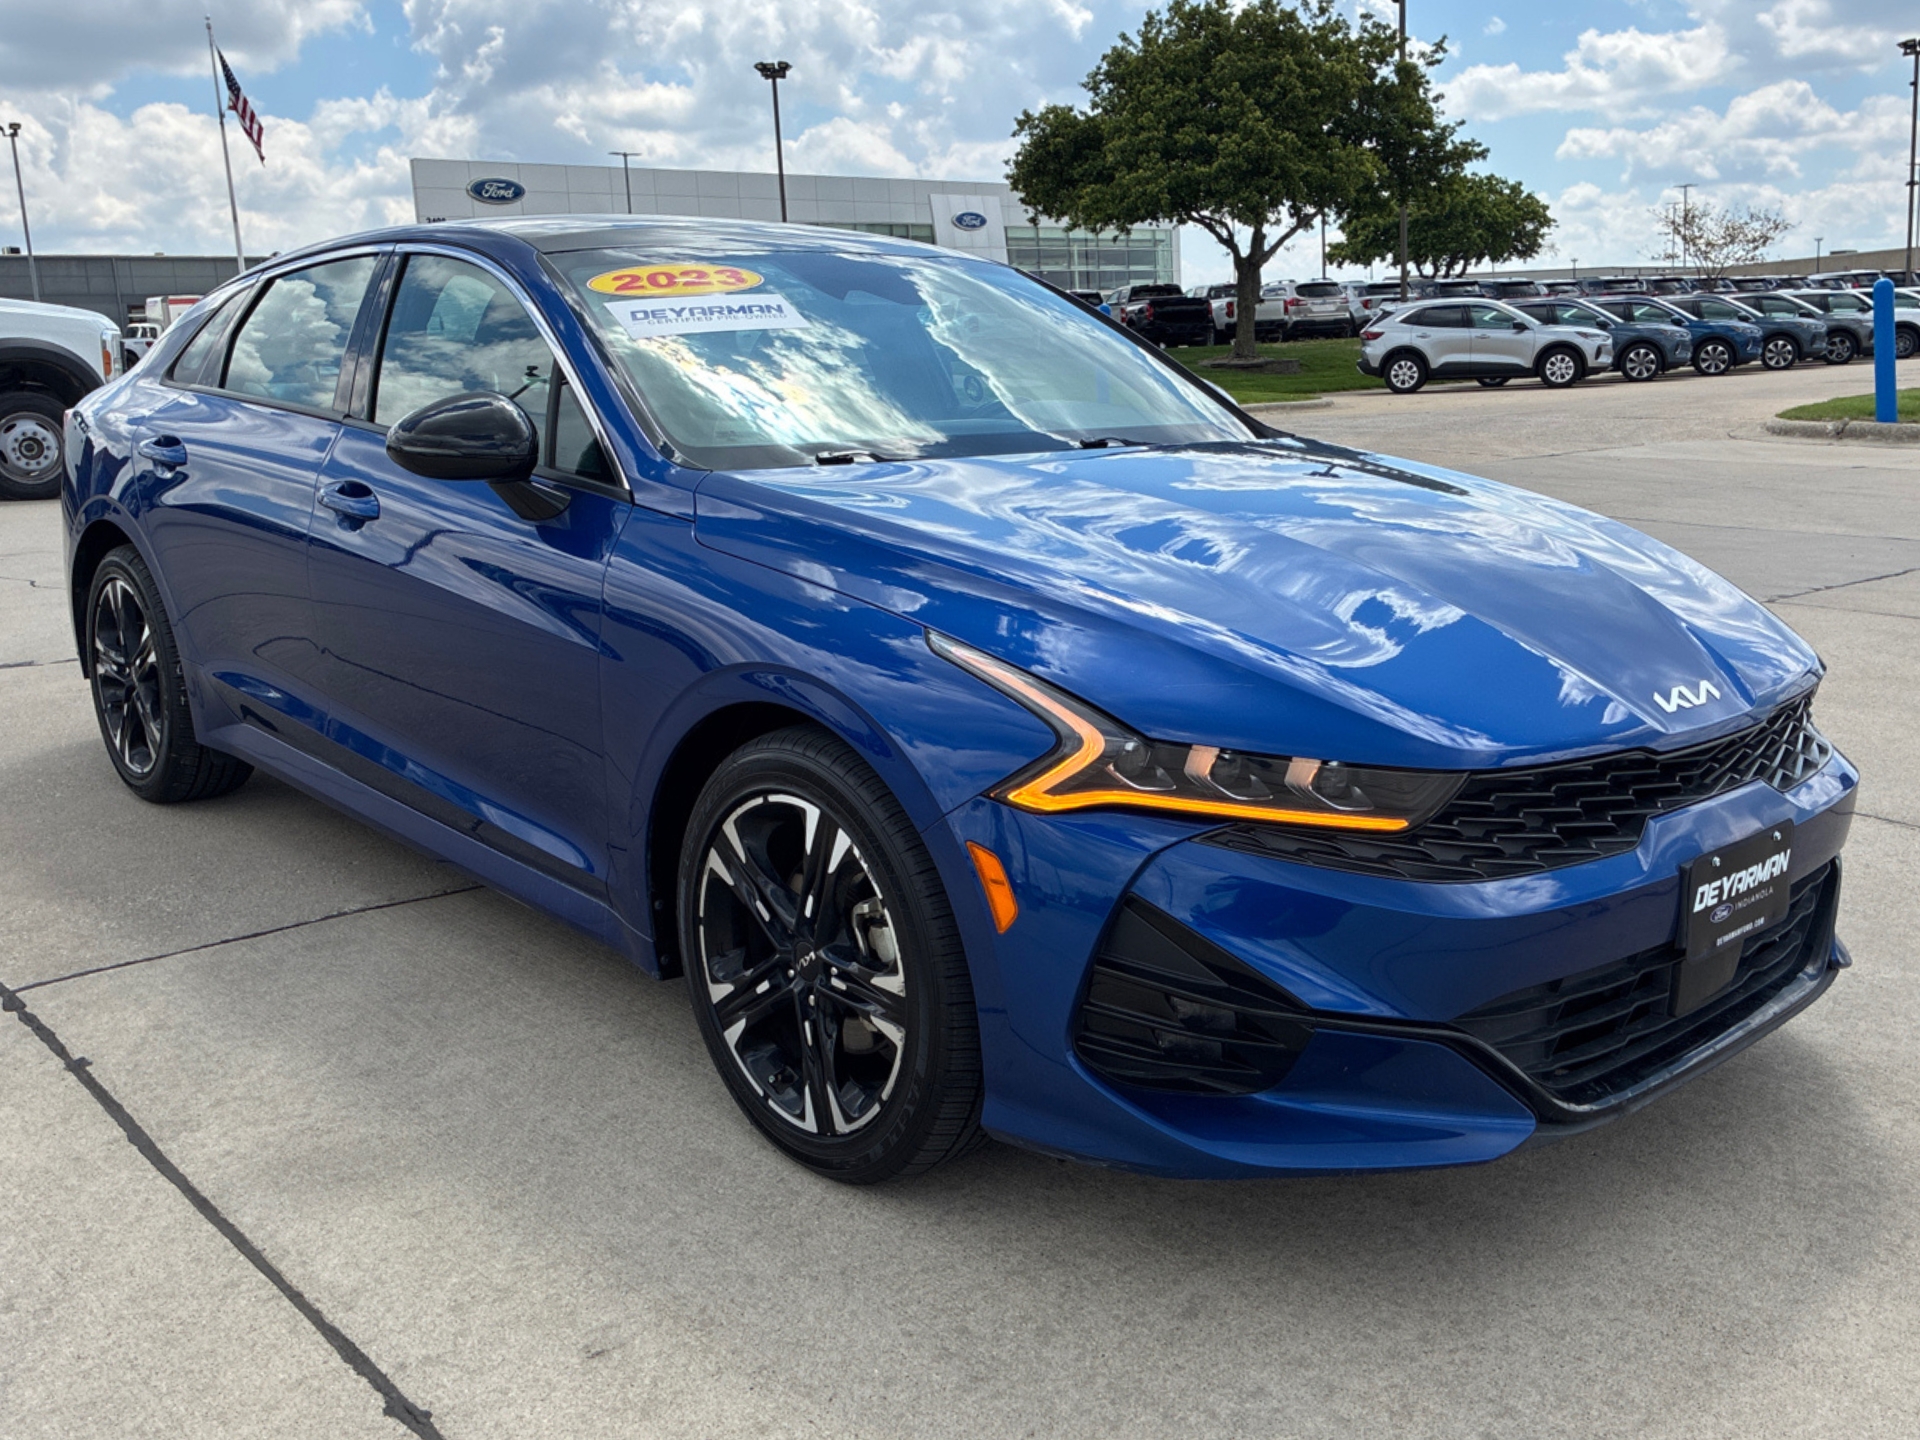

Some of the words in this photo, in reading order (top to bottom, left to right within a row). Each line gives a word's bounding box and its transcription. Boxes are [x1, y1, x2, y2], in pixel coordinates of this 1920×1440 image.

[481, 181, 516, 199] Ford
[961, 214, 982, 227] Ford
[611, 268, 749, 292] 2023
[629, 303, 785, 322] DEYARMAN
[646, 316, 713, 326] CERTIFIED
[716, 312, 788, 322] PRE-OWNED
[1652, 679, 1721, 713] KIA
[1693, 848, 1791, 914] DEYARMAN
[1734, 885, 1774, 911] INDIANOLA
